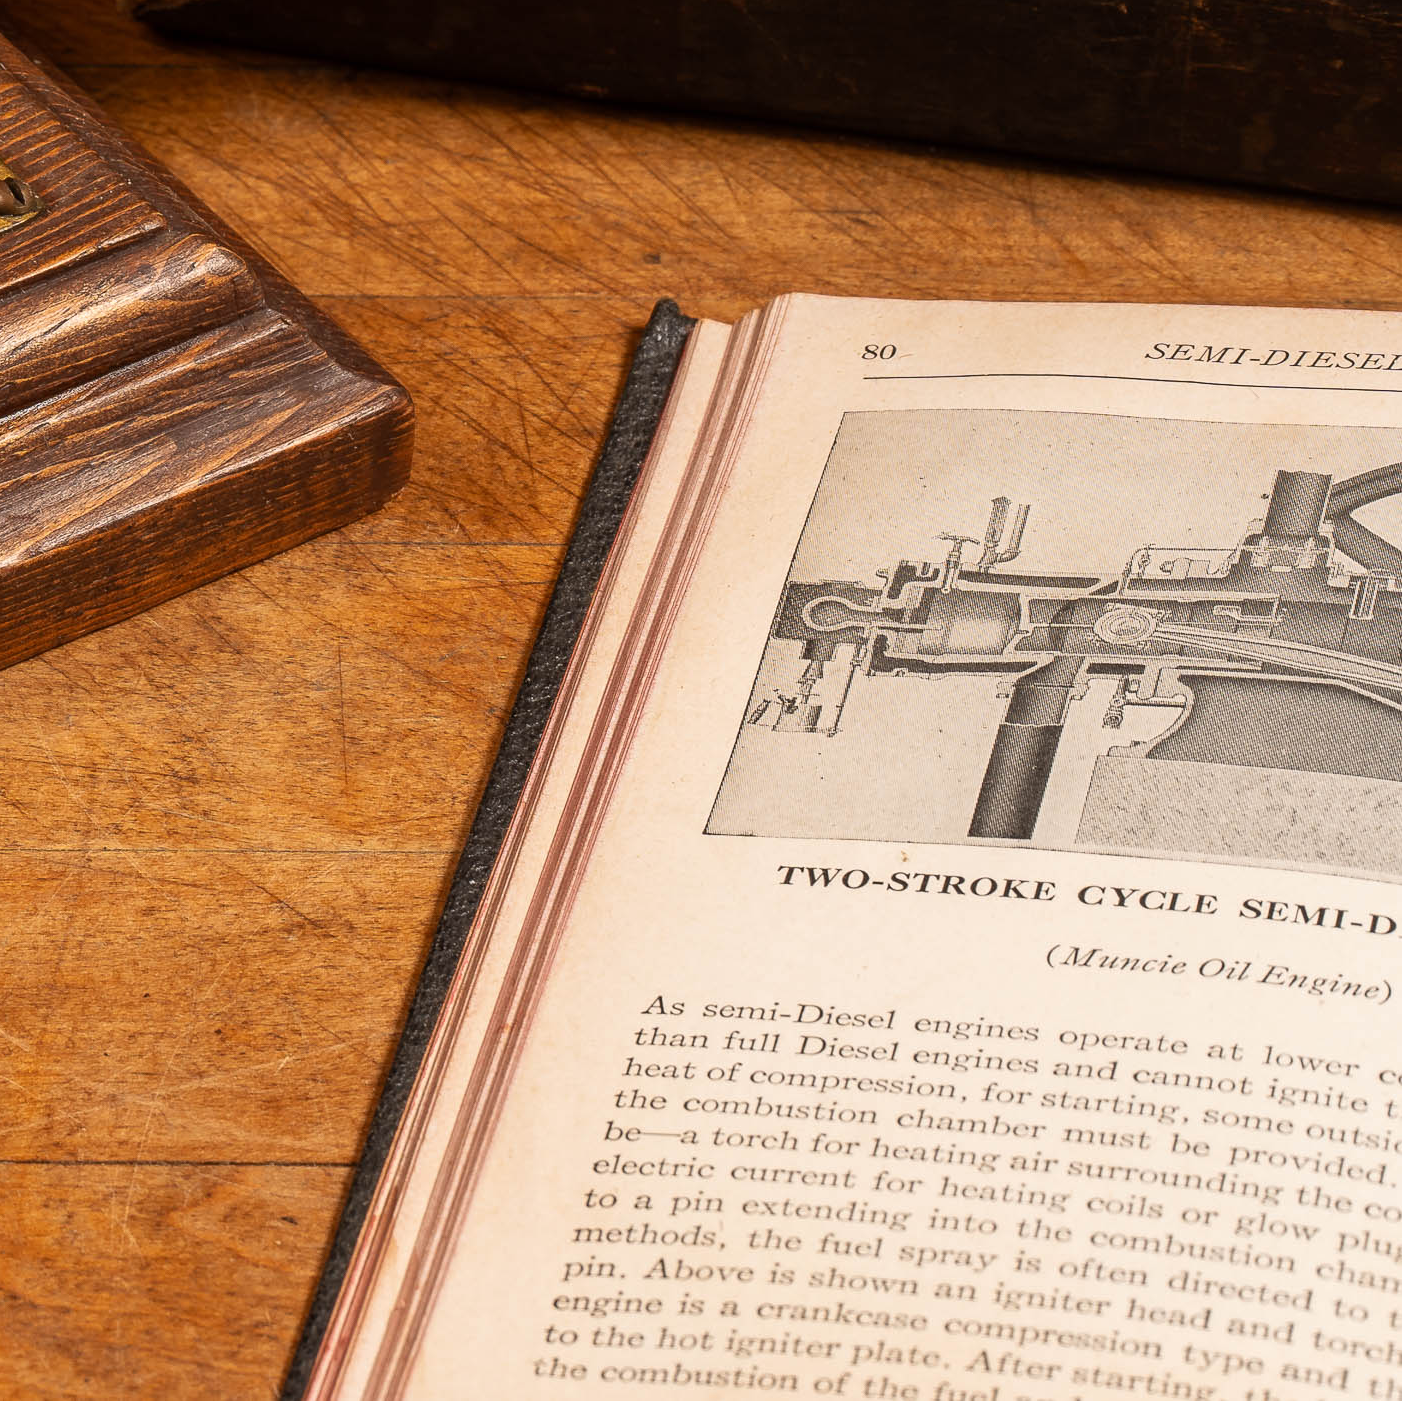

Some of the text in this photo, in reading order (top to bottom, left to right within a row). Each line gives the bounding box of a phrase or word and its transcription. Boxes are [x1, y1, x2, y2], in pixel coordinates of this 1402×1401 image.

[860, 342, 898, 362] 80
[777, 865, 1402, 938] TWO-STROKE CYCLE SEMI-D
[1047, 944, 1392, 1005] (Muncie Oil Engine)
[634, 1027, 708, 1049] than
[723, 1030, 780, 1053] full
[795, 1035, 899, 1062] Diesel
[913, 1049, 1038, 1073] engines
[1053, 1061, 1118, 1080] and
[1133, 1070, 1252, 1095] cannot
[1268, 1078, 1368, 1112] ignite
[641, 995, 1360, 1076] As semi-Diesel engines operate at lower
[622, 1057, 696, 1080] heat
[707, 1062, 743, 1082] of
[750, 1070, 967, 1102] compression,
[981, 1082, 1032, 1104] for
[1041, 1092, 1188, 1123] starting,
[1203, 1110, 1293, 1133] some
[614, 1089, 1395, 1187] the combustion chamber must be provided.
[712, 1128, 798, 1150] torch
[811, 1133, 860, 1155] for
[870, 1137, 1000, 1172] heating
[1010, 1151, 1059, 1172] air
[1068, 1162, 1283, 1205] surrounding
[1298, 1187, 1352, 1211] the
[584, 1189, 617, 1208] to
[634, 1195, 653, 1210] a
[669, 1191, 723, 1216] pin
[742, 1199, 911, 1230] extending
[930, 1208, 997, 1232] into
[1018, 1219, 1071, 1241] the
[1090, 1233, 1295, 1272] combustion
[593, 1154, 715, 1178] electric
[731, 1166, 855, 1188] current
[873, 1171, 923, 1193] for
[940, 1176, 1069, 1212] heating
[1087, 1195, 1163, 1218] coils
[1182, 1210, 1218, 1225] or
[1235, 1213, 1318, 1240] glow
[563, 1255, 625, 1282] pin.
[643, 1257, 754, 1281] Above
[770, 1262, 795, 1284] is
[809, 1268, 917, 1295] shown
[934, 1284, 975, 1301] an
[995, 1282, 1111, 1315] igniter
[1127, 1299, 1211, 1330] head
[1228, 1320, 1294, 1344] and
[573, 1223, 725, 1250] methods,
[749, 1229, 801, 1250] the
[819, 1233, 883, 1258] fuel
[899, 1247, 997, 1272] spray
[1016, 1250, 1041, 1272] is
[1059, 1258, 1147, 1285] often
[1168, 1271, 1313, 1311] directed
[1335, 1300, 1368, 1320] to
[535, 1357, 587, 1378] the
[601, 1363, 797, 1390] combustion
[814, 1373, 851, 1394] of
[864, 1377, 918, 1399] the
[545, 1326, 578, 1344] to
[592, 1326, 644, 1347] the
[658, 1328, 712, 1350] hot
[726, 1329, 841, 1357] igniter
[851, 1341, 949, 1368] plate.
[967, 1350, 1061, 1379] After
[552, 1291, 663, 1317] engine
[679, 1293, 704, 1314] is
[720, 1302, 738, 1316] a
[756, 1303, 927, 1329] crankcase
[944, 1321, 1161, 1358] compression
[1185, 1346, 1263, 1374] type
[1281, 1365, 1349, 1390] and
